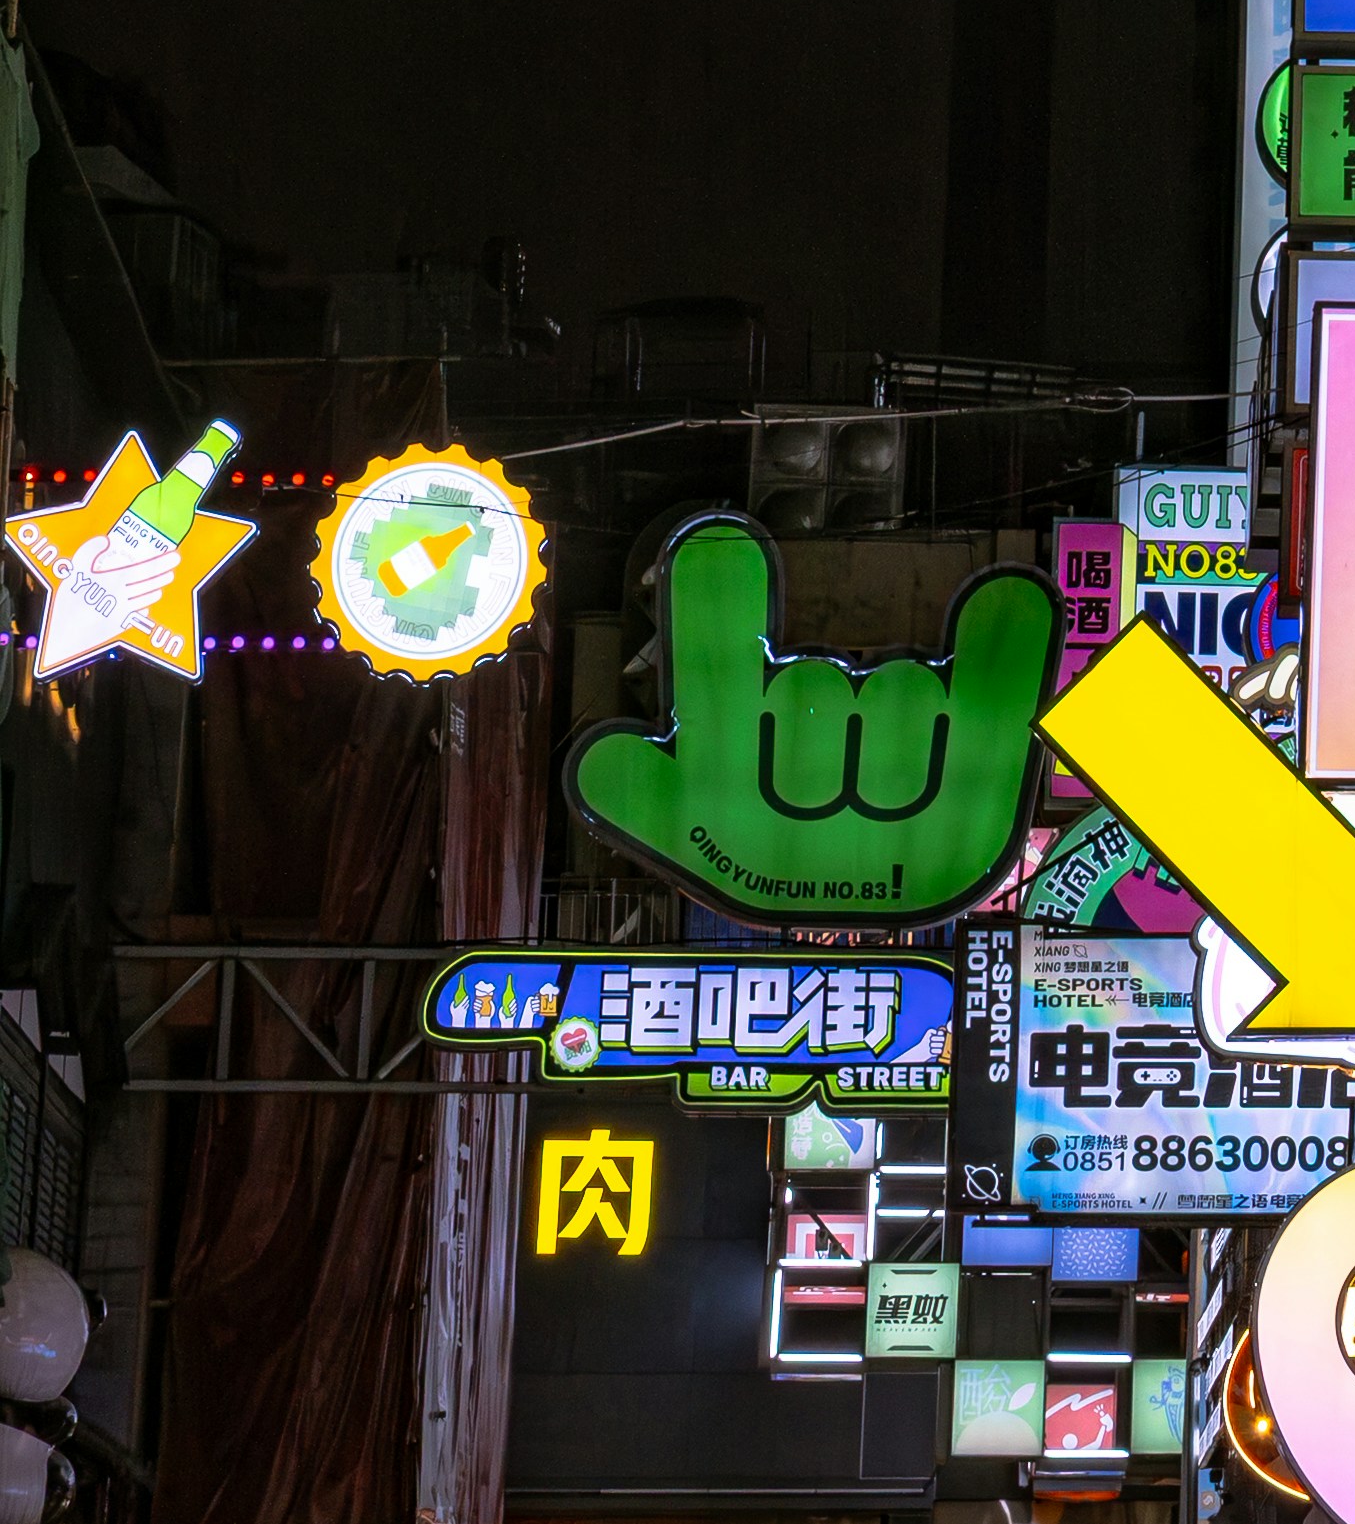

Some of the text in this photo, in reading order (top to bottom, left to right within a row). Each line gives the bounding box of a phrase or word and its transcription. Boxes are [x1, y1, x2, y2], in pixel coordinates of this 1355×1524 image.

[689, 825, 816, 900] QINGYUNFUN
[1034, 945, 1070, 957] XIANG
[965, 929, 987, 1029] HOTEL
[1034, 961, 1061, 973] XING
[1034, 978, 1143, 992] E-SPORTS
[600, 966, 903, 1057] 酒吧街
[989, 929, 1013, 1084] E-SPORTS
[1033, 994, 1104, 1008] HOTEL
[710, 1065, 945, 1092] BAR STREET
[1063, 1134, 1350, 1173] 0851 88630008
[1064, 1134, 1129, 1151] 订房热线
[536, 1129, 655, 1257] 肉
[1051, 1199, 1133, 1210] E-SPORTS HOTEL
